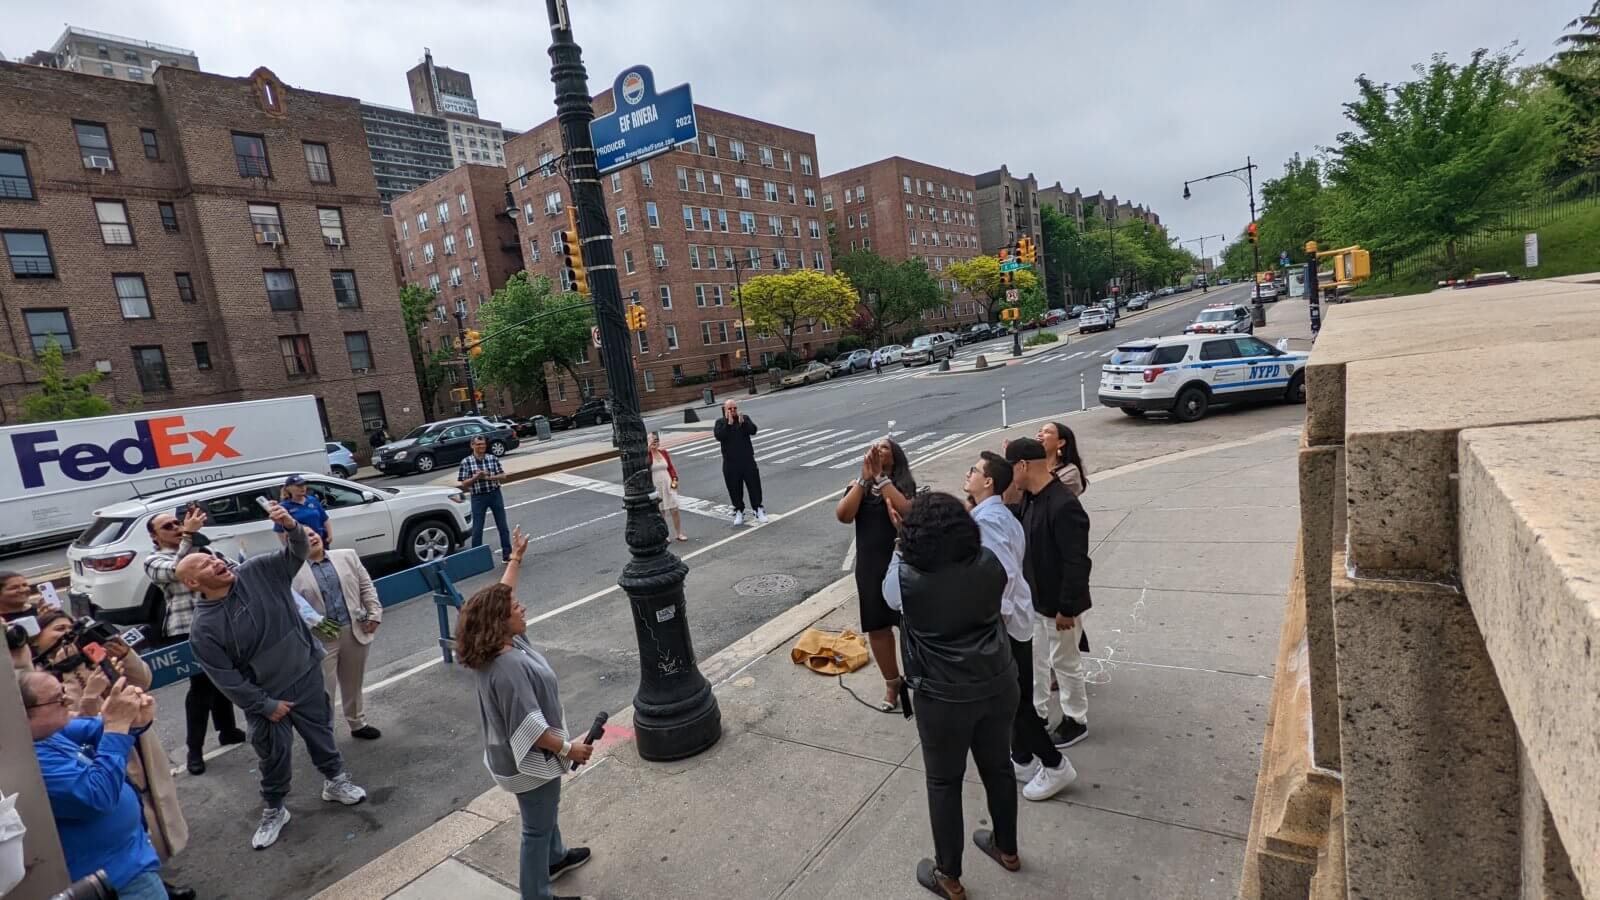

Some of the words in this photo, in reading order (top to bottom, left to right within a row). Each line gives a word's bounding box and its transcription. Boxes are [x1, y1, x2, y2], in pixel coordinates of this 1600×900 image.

[619, 116, 630, 133] EIF
[631, 105, 658, 129] RIVERA
[675, 115, 692, 128] 2022
[596, 139, 626, 157] PRODUCER
[1249, 365, 1280, 379] NYPD
[10, 416, 243, 489] FedEx
[164, 470, 223, 488] Ground
[123, 632, 137, 642] 12
[151, 651, 181, 670] INE
